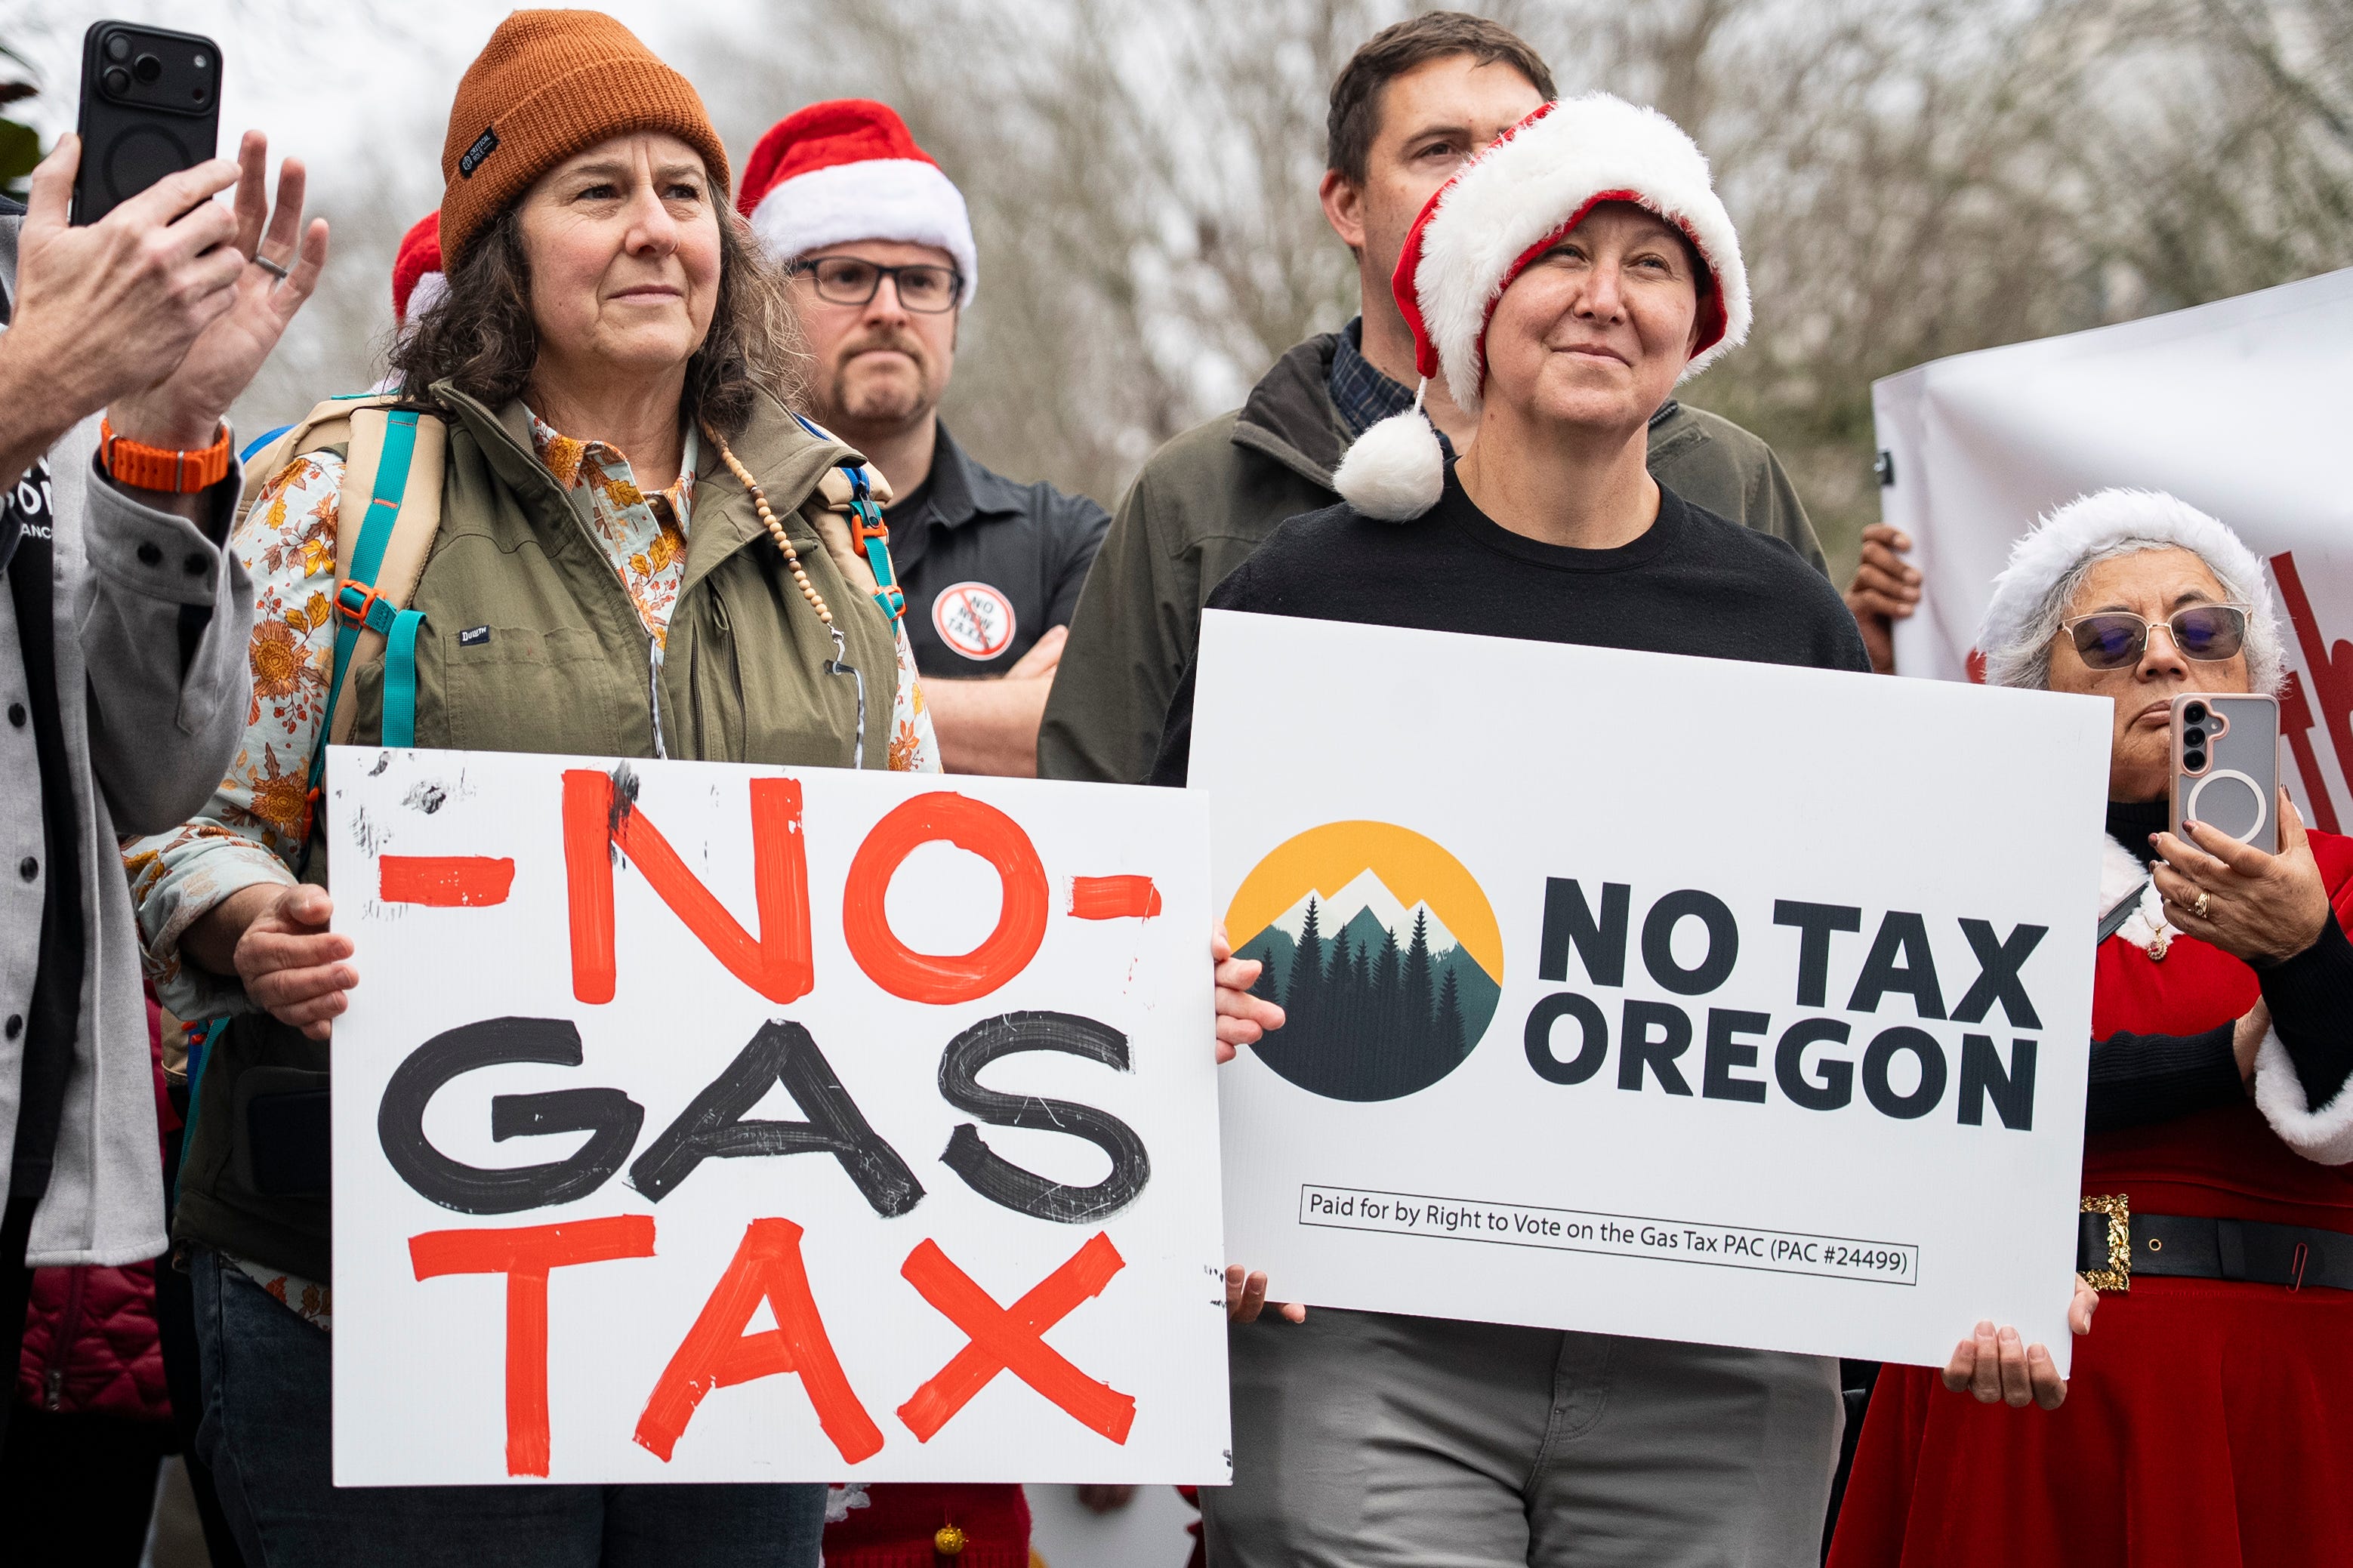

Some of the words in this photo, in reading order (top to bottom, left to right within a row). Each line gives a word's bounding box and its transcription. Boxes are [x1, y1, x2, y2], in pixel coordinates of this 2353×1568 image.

[470, 134, 490, 156] CRITICAL
[472, 149, 485, 162] ROLE
[970, 596, 993, 614] NO
[1539, 877, 1738, 995] NO
[1773, 899, 2049, 1030] TAX
[378, 1010, 1150, 1222] GAS
[1525, 993, 2037, 1131] OREGON
[1311, 1194, 1353, 1216] Paid
[1361, 1198, 1389, 1218] for
[1395, 1201, 1420, 1227] by
[1427, 1206, 1481, 1231] Right
[1488, 1213, 1508, 1231] to
[1515, 1214, 1560, 1236] Vote
[1568, 1224, 1593, 1240] on
[1601, 1222, 1633, 1244] the
[1641, 1227, 1677, 1248] Gas
[1684, 1231, 1717, 1252] Tax
[1725, 1235, 1763, 1256] PAC
[1772, 1240, 1817, 1262] (PAC
[1824, 1246, 1907, 1274] #24499)
[409, 1215, 1136, 1477] TAX
